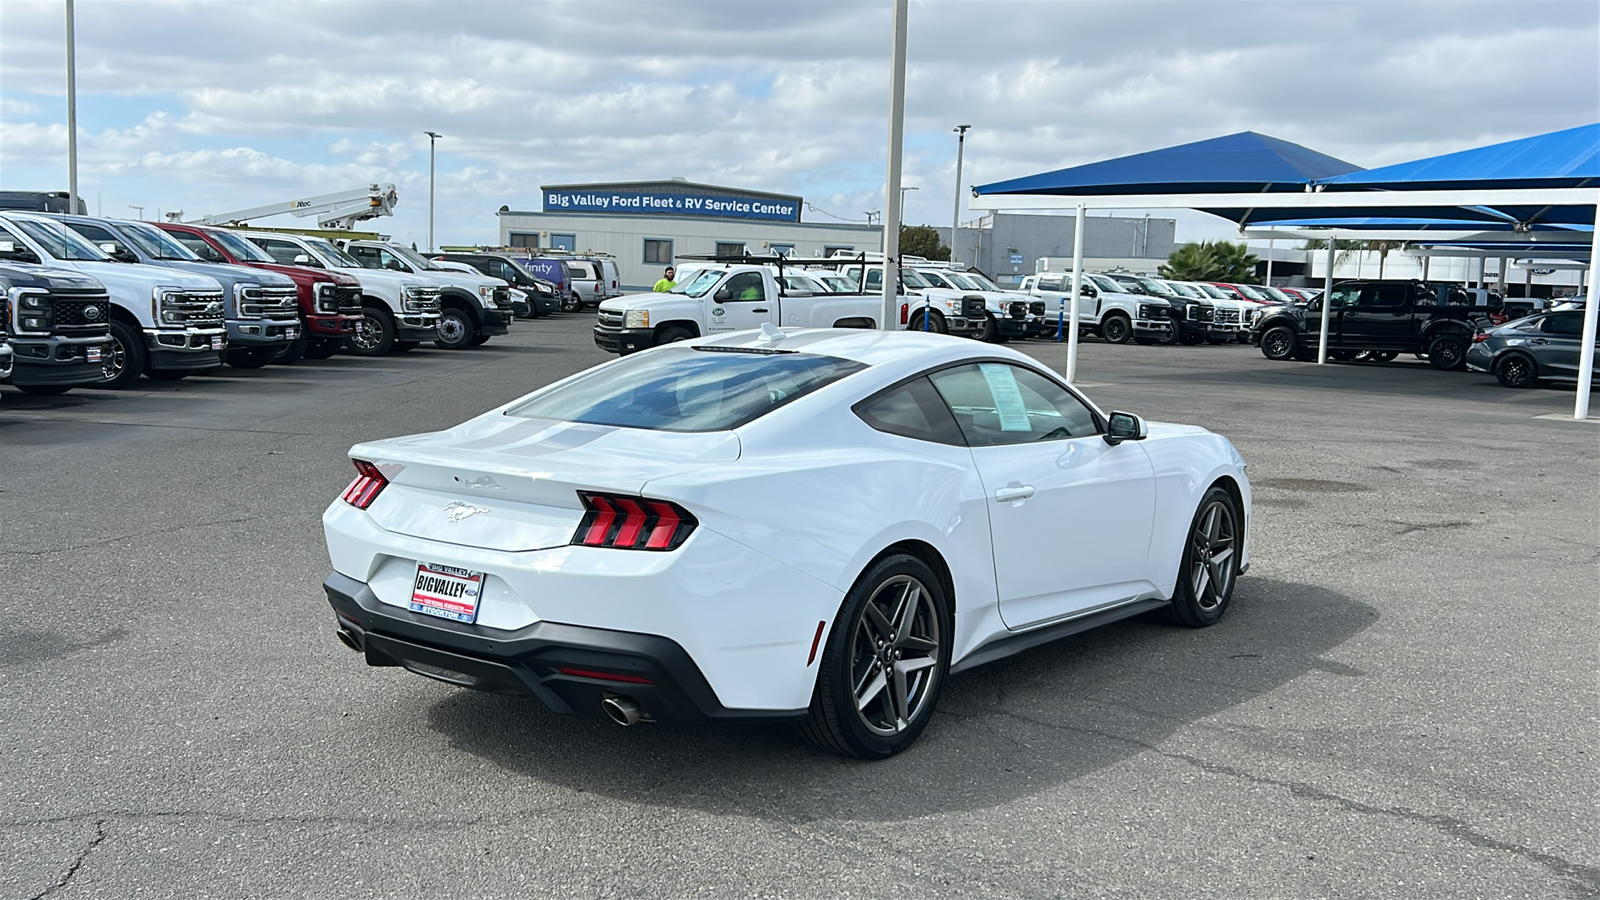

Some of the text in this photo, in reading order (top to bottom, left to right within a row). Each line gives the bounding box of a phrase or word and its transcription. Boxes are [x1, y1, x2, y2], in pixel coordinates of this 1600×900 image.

[549, 194, 793, 216] Big Valley Ford Fleet & RV Service Center
[525, 262, 552, 274] finity
[431, 564, 468, 576] BIG VALLEY
[416, 575, 467, 598] BIGVALLEY
[423, 606, 459, 619] STOCKTON
